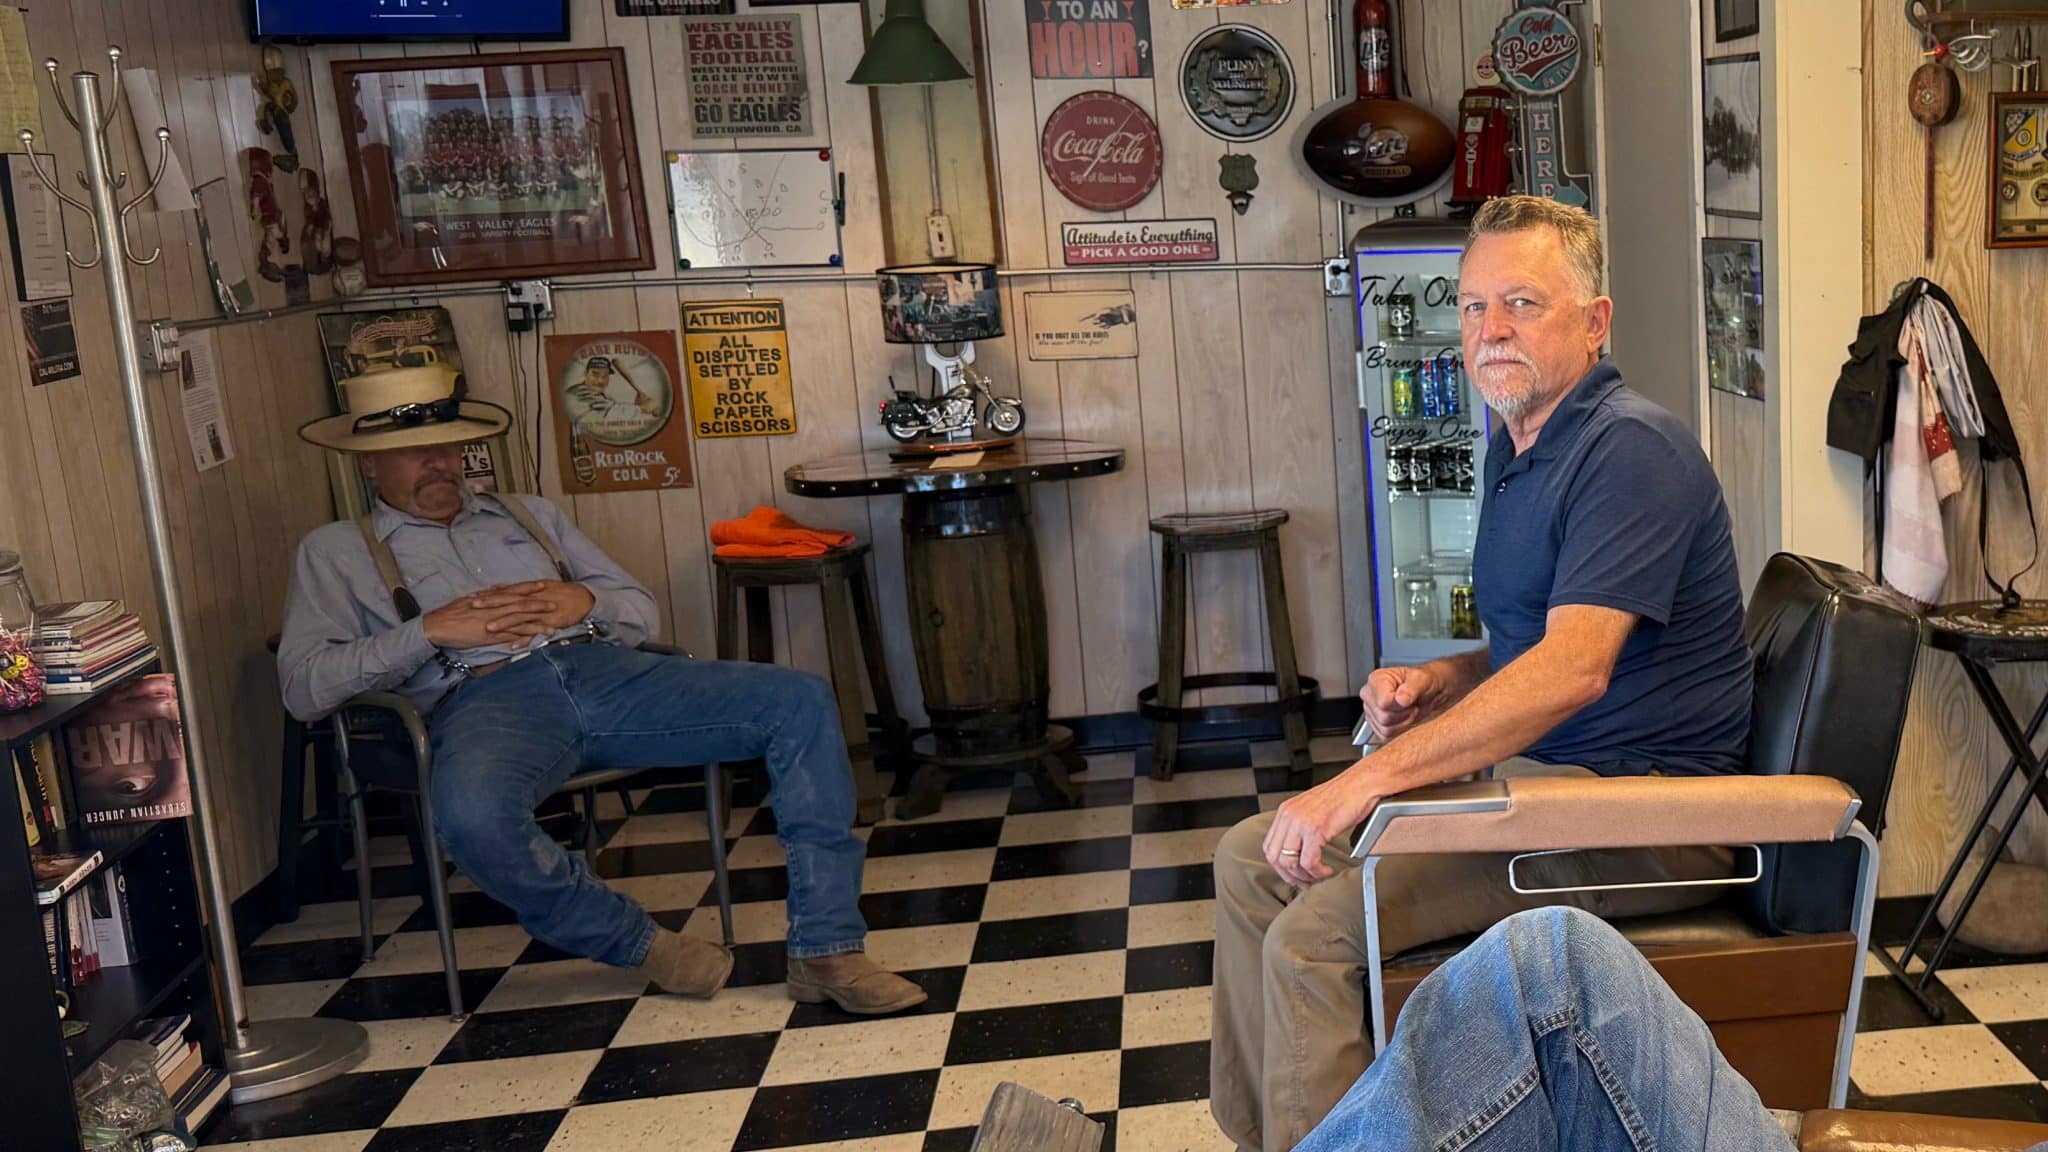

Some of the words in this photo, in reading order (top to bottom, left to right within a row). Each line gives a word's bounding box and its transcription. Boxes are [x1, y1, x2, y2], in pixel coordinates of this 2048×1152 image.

[1058, 0, 1084, 20] TO
[1090, 0, 1119, 20] AN
[684, 22, 731, 33] WEST
[735, 20, 792, 32] VALLEY
[1519, 13, 1556, 36] Cold
[687, 32, 794, 51] EAGLES
[689, 51, 796, 66] FOOTBALL
[1501, 34, 1578, 69] Beer
[1218, 59, 1259, 73] PLINY
[694, 104, 723, 123] GO
[728, 103, 802, 123] EAGLES
[1086, 115, 1116, 126] DRINK
[1532, 112, 1556, 199] HERE
[446, 221, 471, 231] WEST
[477, 219, 514, 229] VALLEY
[519, 217, 557, 227] EAGLES
[1067, 227, 1124, 245] Attitude
[1126, 231, 1137, 244] is
[1140, 225, 1213, 245] Everything
[1081, 247, 1113, 258] PICK
[1116, 247, 1127, 257] A
[1129, 245, 1169, 256] GOOD
[1172, 245, 1200, 255] ONE
[1424, 276, 1459, 307] On
[689, 310, 778, 326] ATTENTION
[719, 335, 754, 349] ALL
[693, 348, 782, 364] DISPUTES
[1366, 346, 1424, 375] Bring
[1436, 347, 1464, 370] On
[699, 362, 779, 378] SETTLED
[729, 377, 753, 391] BY
[717, 391, 769, 406] ROCK
[714, 405, 774, 419] PAPER
[700, 418, 791, 435] SCISSORS
[1370, 415, 1432, 444] Enjoy
[1439, 416, 1485, 440] One
[613, 468, 649, 481] COLA
[67, 718, 181, 769] WAR
[86, 807, 125, 824] JUNGER
[130, 801, 186, 820] SEBASTIAN
